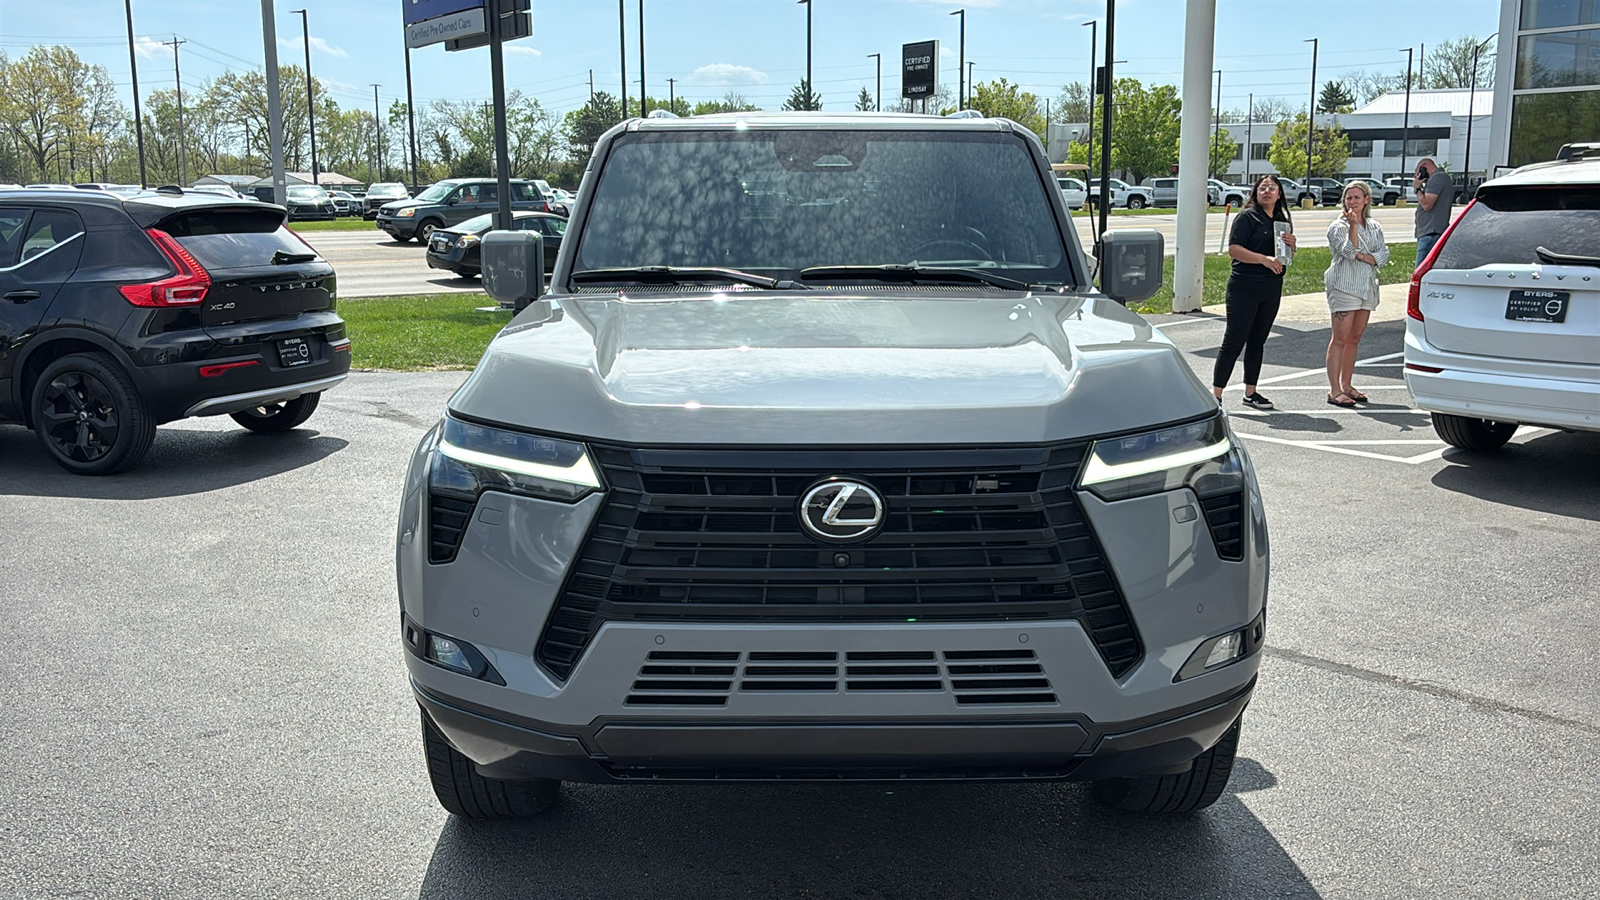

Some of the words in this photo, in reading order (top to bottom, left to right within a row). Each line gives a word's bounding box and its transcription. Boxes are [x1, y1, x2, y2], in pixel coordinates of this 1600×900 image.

[411, 26, 429, 40] Certified
[430, 25, 438, 36] Pre
[439, 21, 457, 34] Owned
[458, 18, 472, 30] Cars
[905, 56, 930, 65] CERTIFIED
[260, 281, 317, 292] VOLVO
[1524, 290, 1554, 298] BYERS
